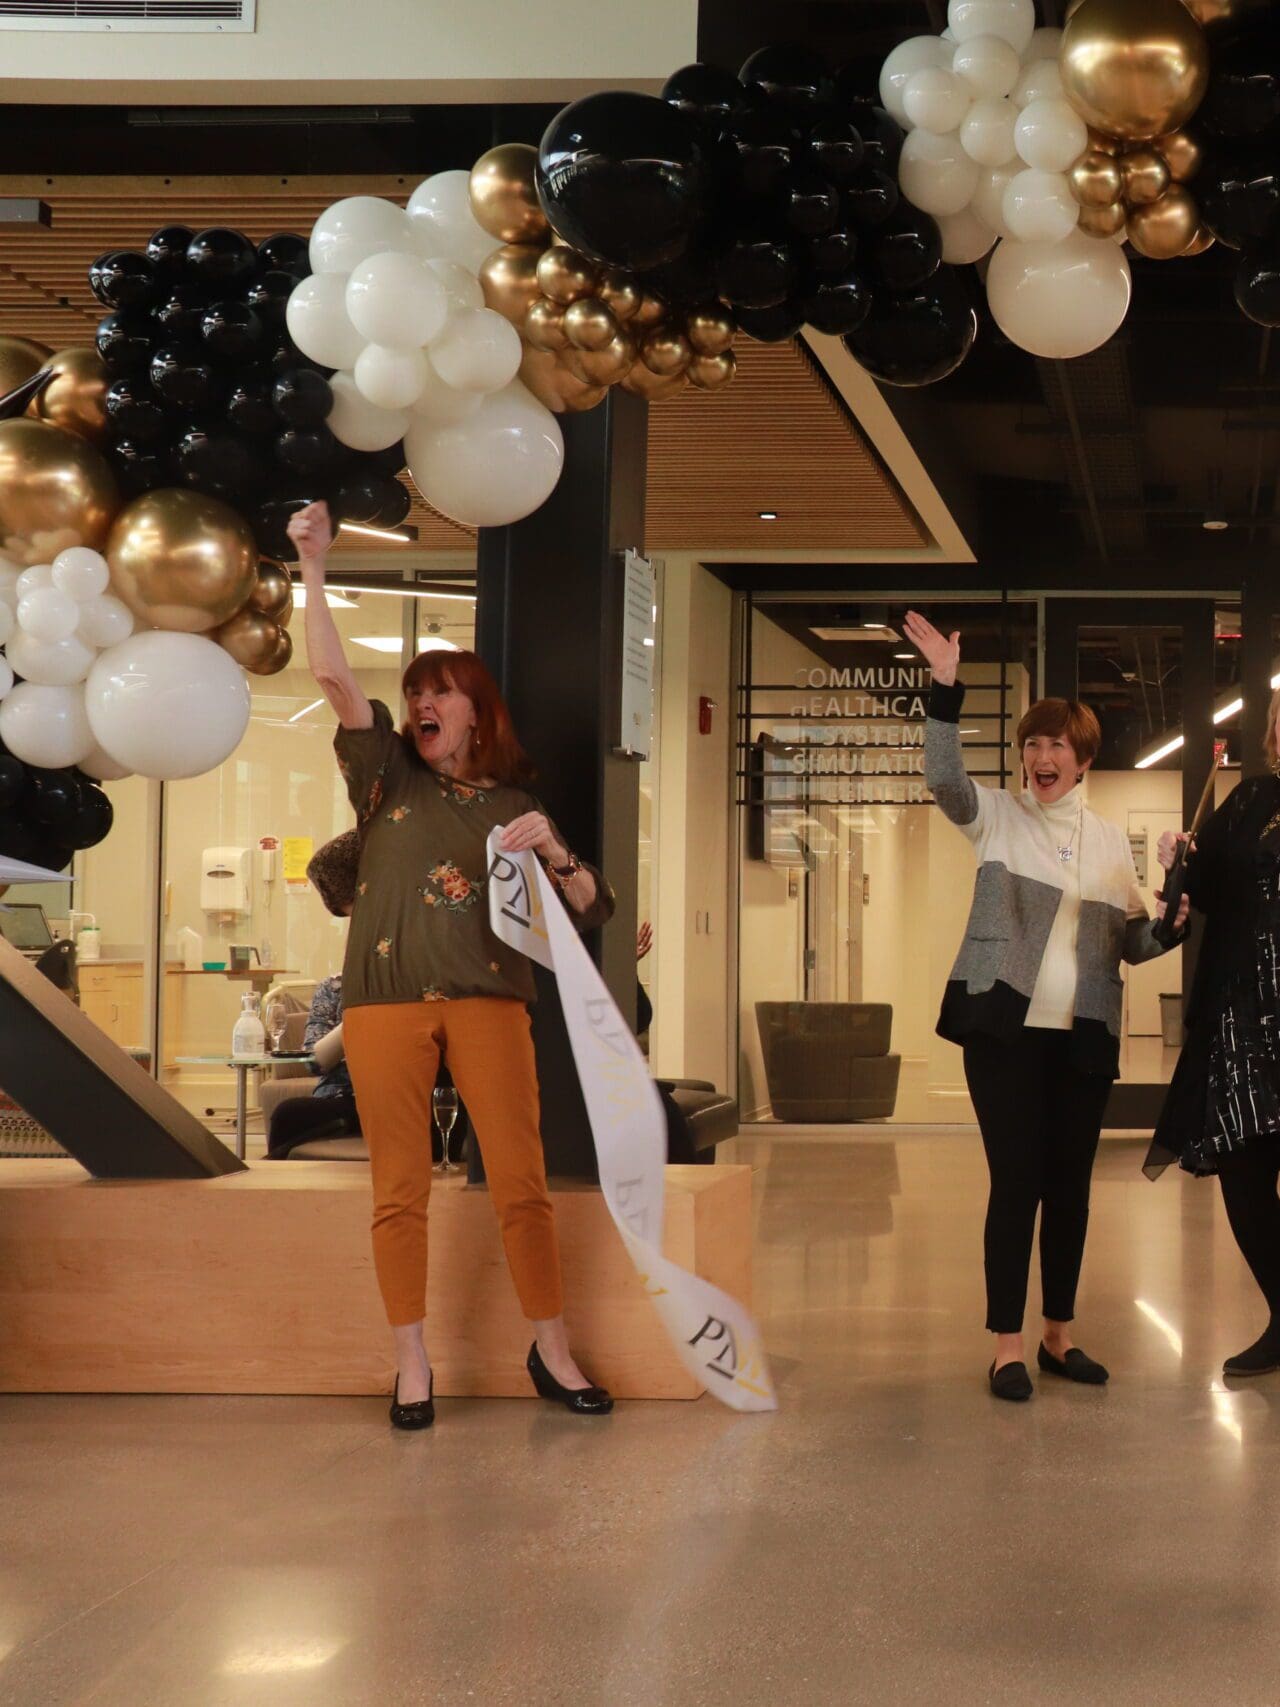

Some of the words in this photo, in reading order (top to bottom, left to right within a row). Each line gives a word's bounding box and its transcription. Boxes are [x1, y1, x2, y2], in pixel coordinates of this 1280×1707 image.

[795, 667, 933, 688] COMMUNIT
[790, 696, 927, 717] HEALTHCA
[823, 725, 925, 746] SYSTEM
[824, 782, 923, 803] CENTER
